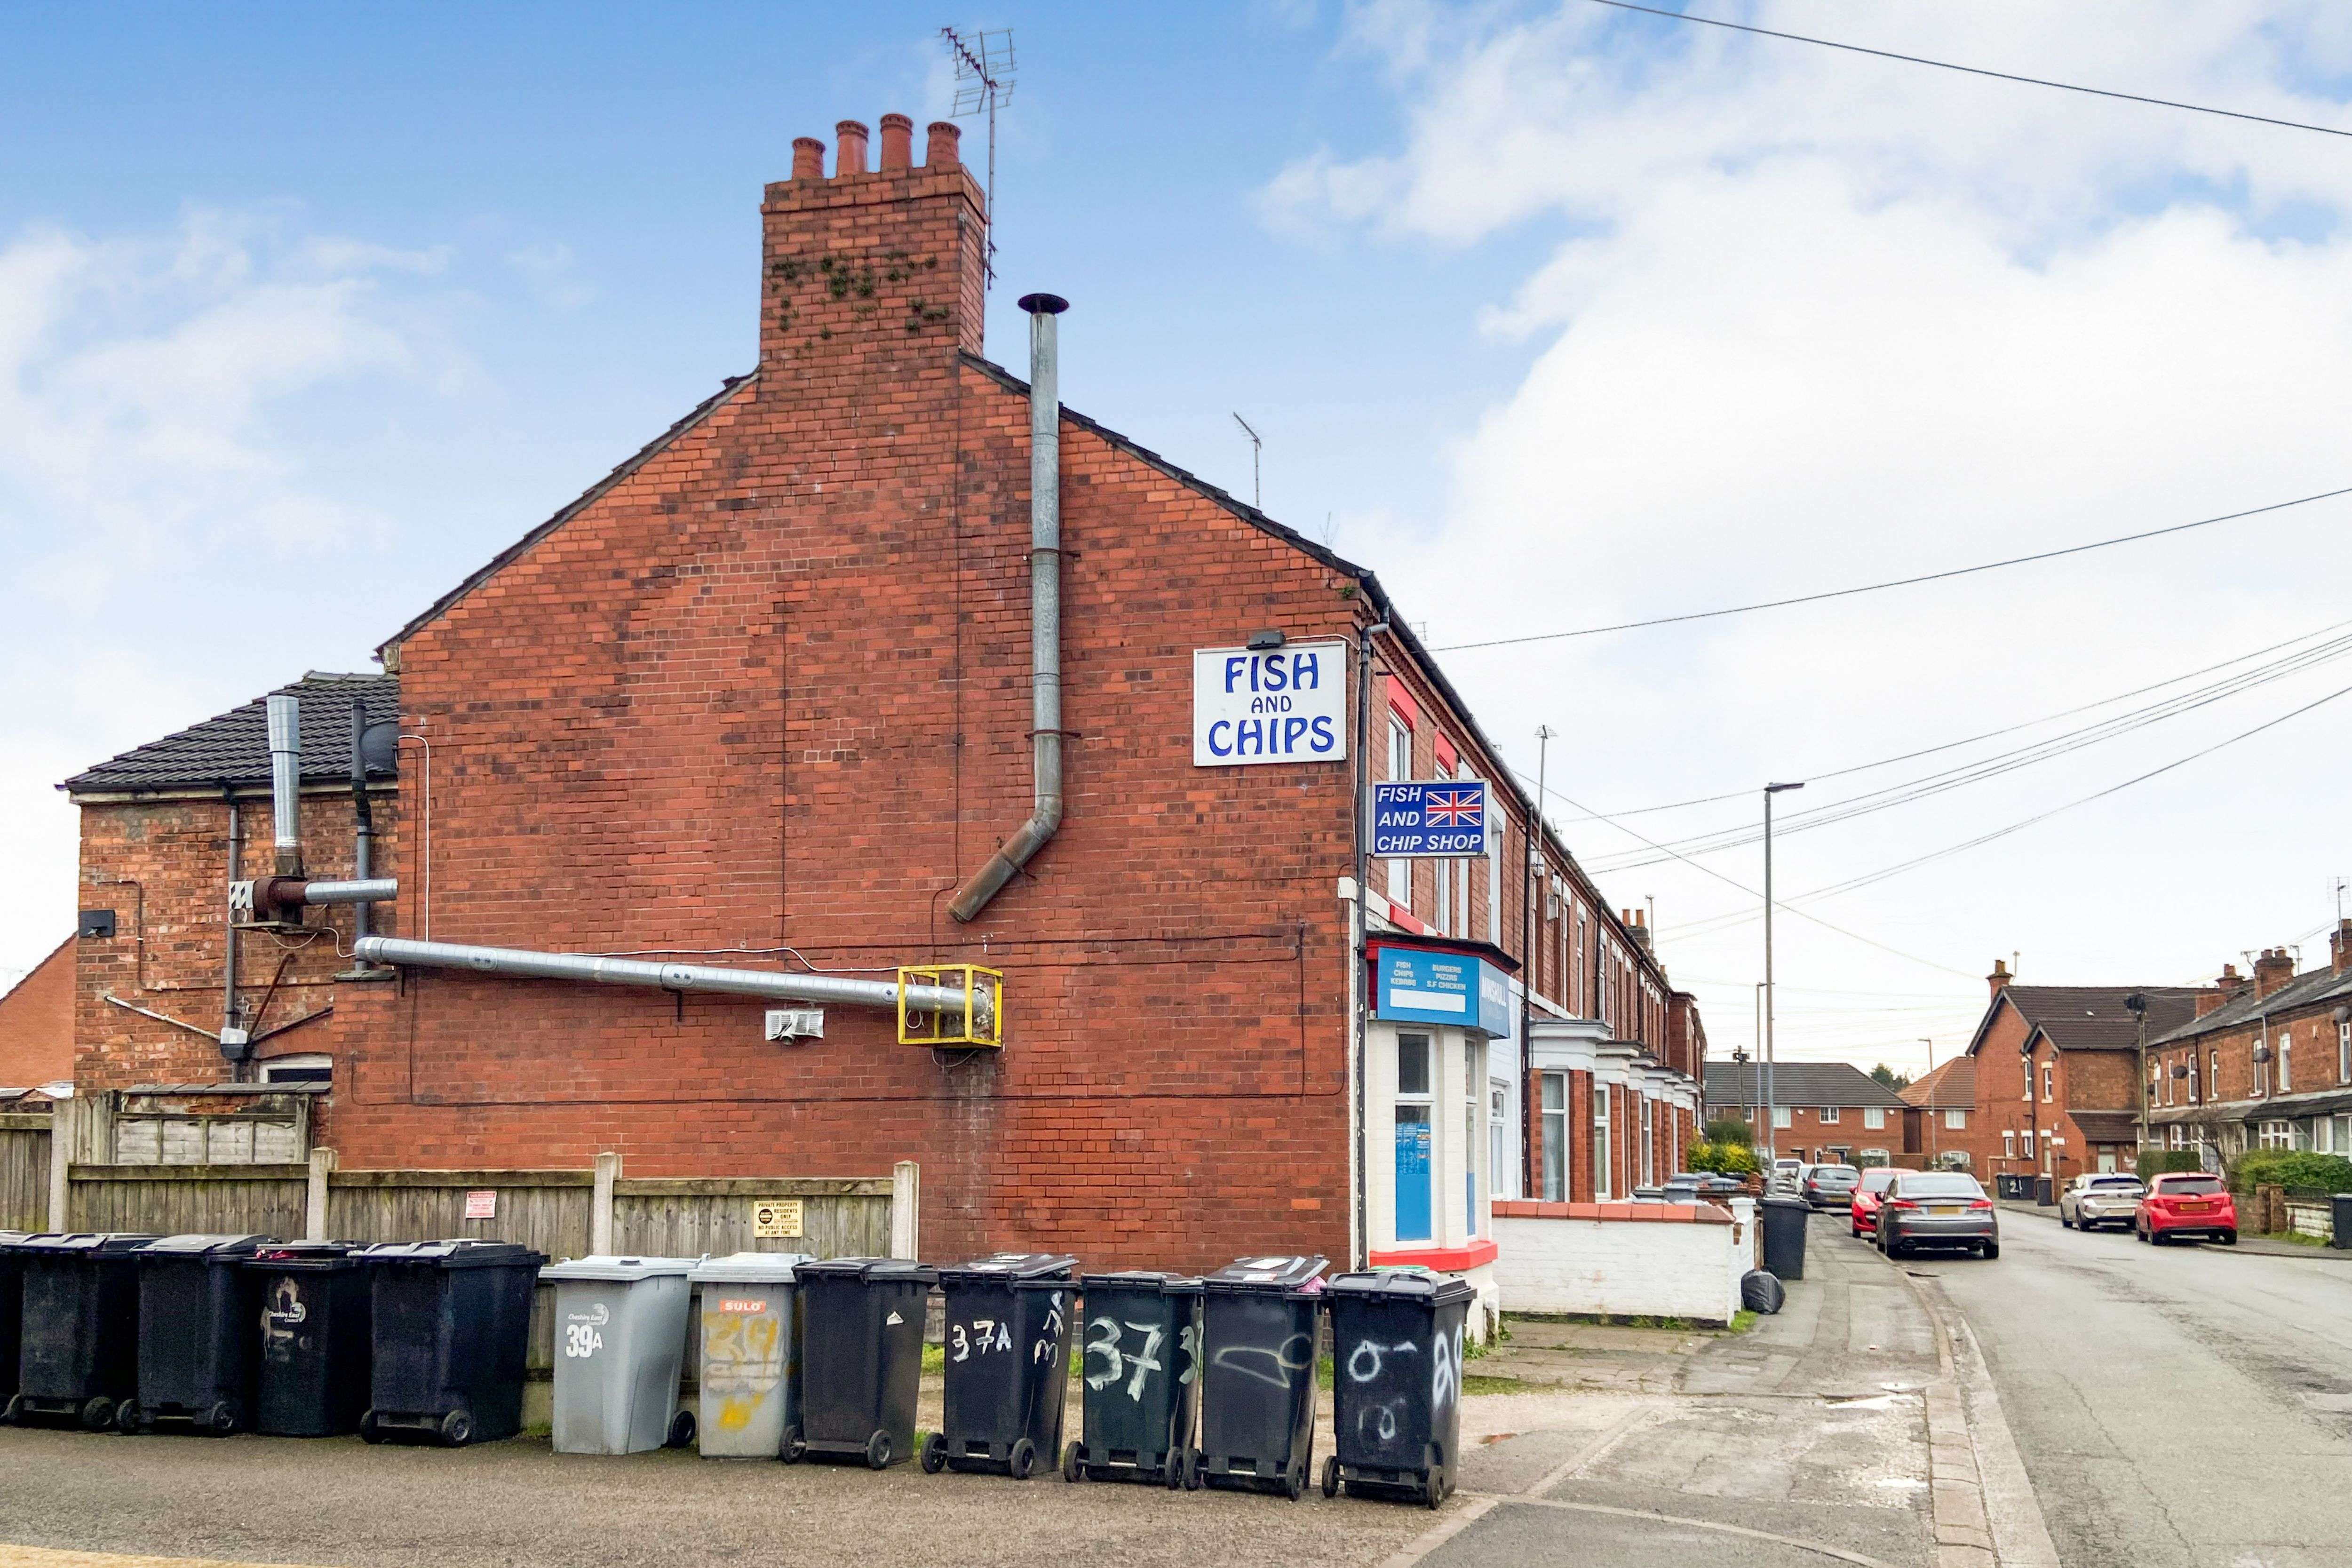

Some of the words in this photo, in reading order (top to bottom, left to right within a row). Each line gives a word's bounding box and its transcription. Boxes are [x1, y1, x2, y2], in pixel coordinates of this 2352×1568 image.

[1225, 653, 1319, 693] FISH
[1251, 695, 1292, 714] AND
[1208, 716, 1335, 757] CHIPS
[1377, 787, 1422, 803] FISH
[1378, 812, 1420, 827] AND
[1377, 835, 1422, 851] CHIP
[1426, 834, 1481, 851] SHOP
[1432, 964, 1462, 974] BURGERS
[1391, 978, 1416, 986] KEBABS
[1438, 981, 1466, 990] CHICKEN
[725, 1302, 761, 1311] SULO
[952, 1320, 1012, 1362] 37A
[1086, 1316, 1167, 1402] 37
